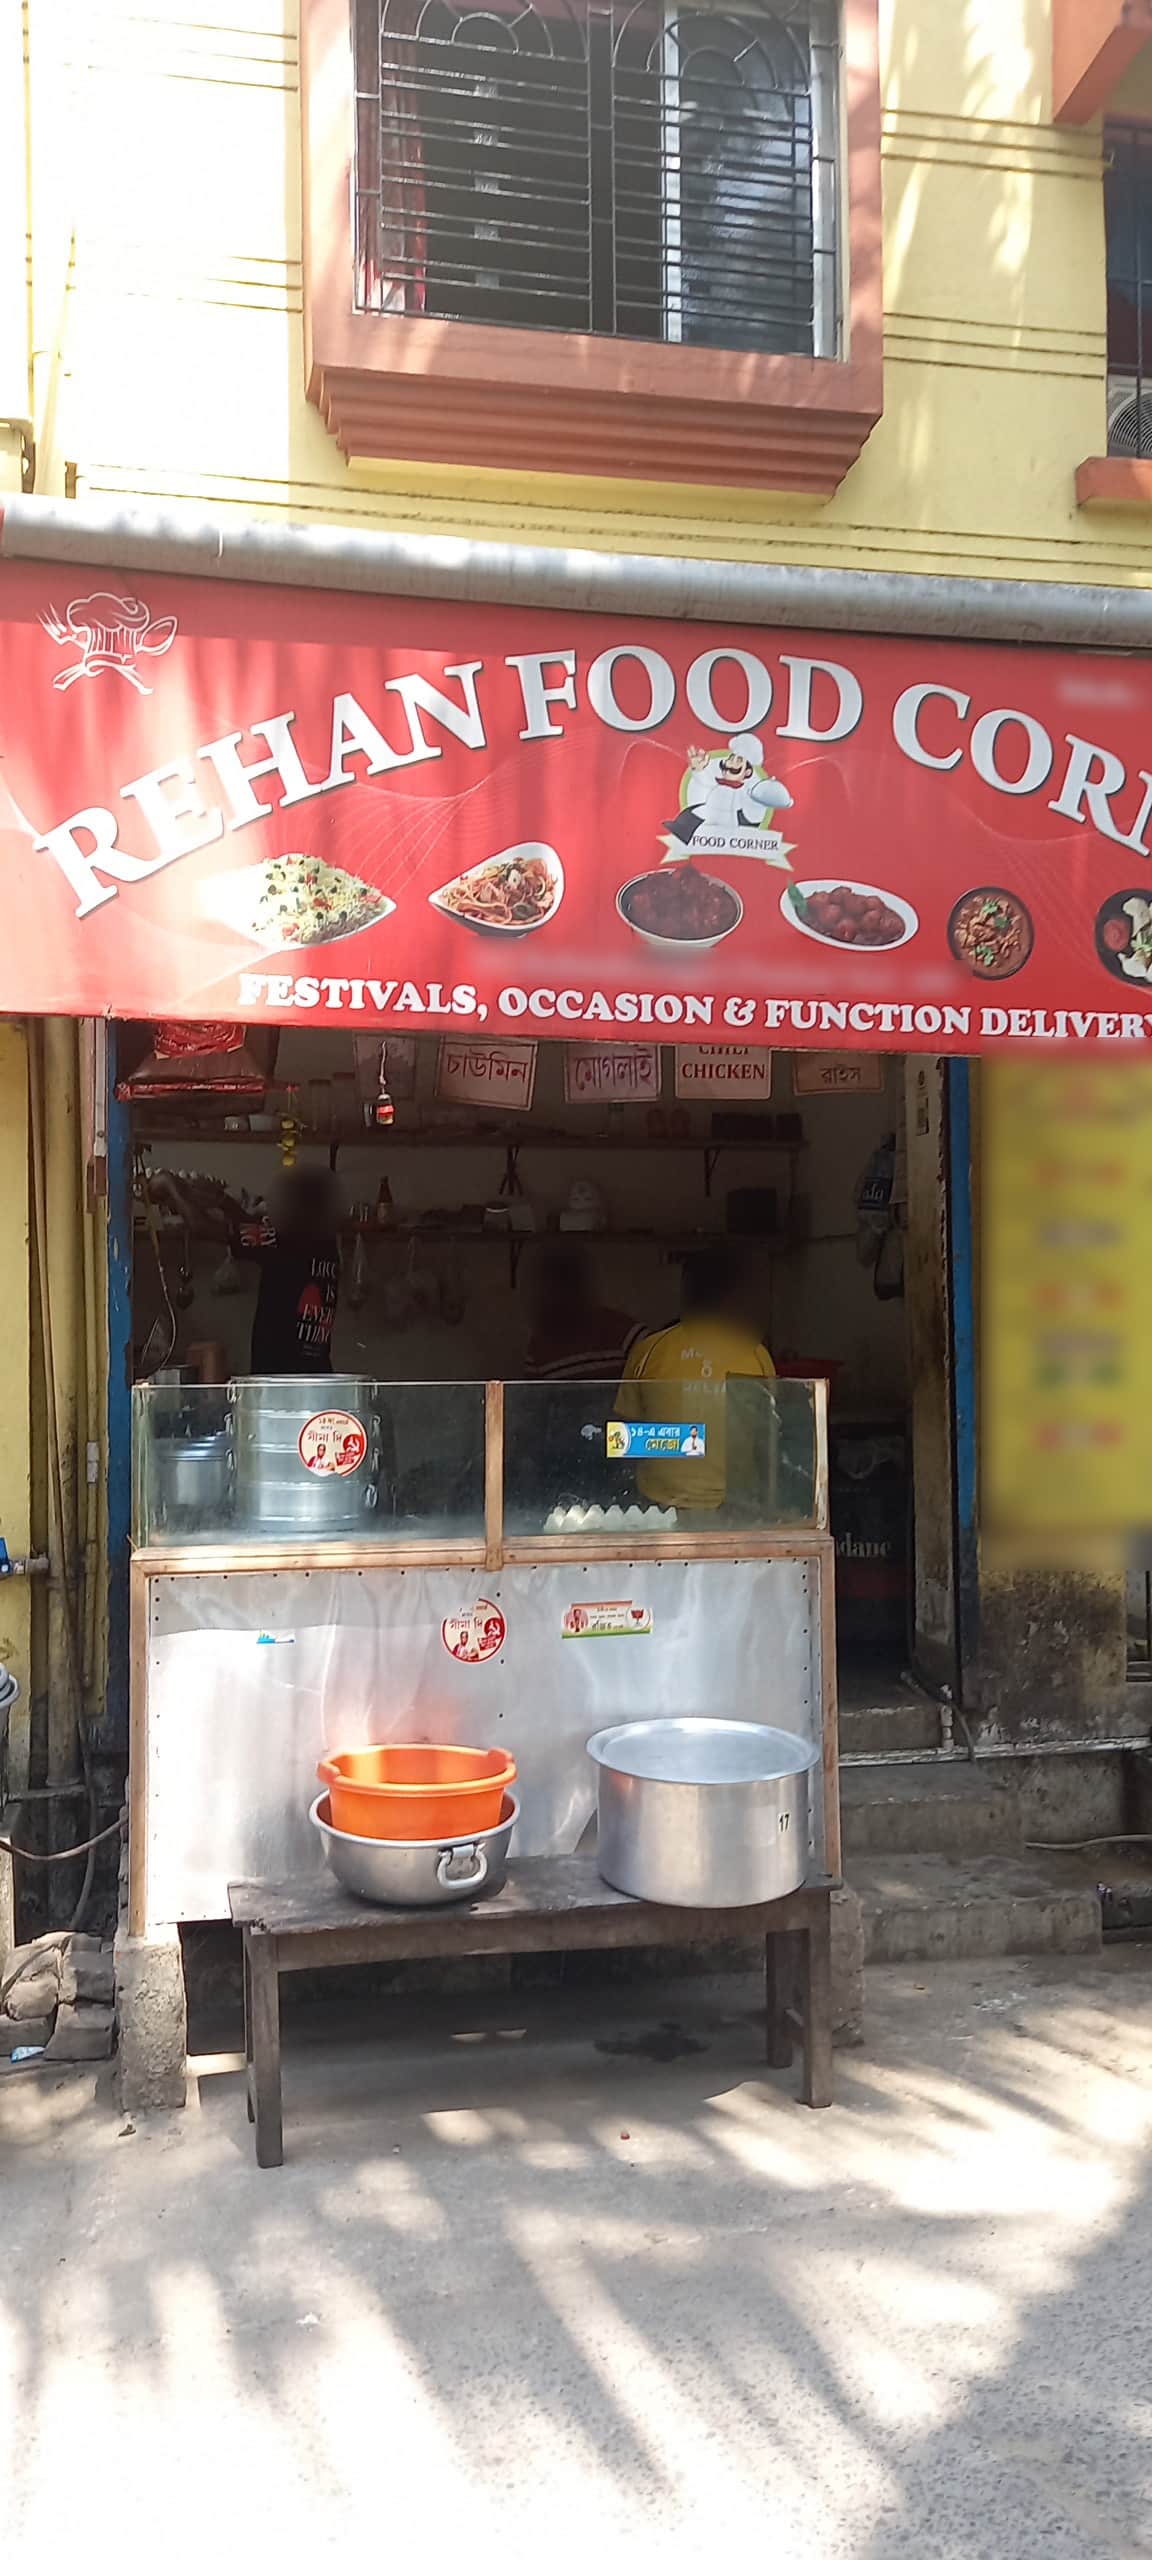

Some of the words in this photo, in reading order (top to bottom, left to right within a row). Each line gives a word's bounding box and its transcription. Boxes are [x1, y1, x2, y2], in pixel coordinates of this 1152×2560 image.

[34, 660, 488, 920] REHAN
[505, 645, 863, 743] FOOD
[892, 683, 1152, 858] COR
[691, 835, 726, 848] FOOD
[729, 837, 779, 851] CORNER
[238, 973, 488, 1022] FESTIVALS,
[499, 986, 715, 1027] OCCASION
[722, 996, 755, 1027] &
[765, 1000, 972, 1037] FUNCTION
[446, 1048, 528, 1083] চাউমিন
[681, 1063, 766, 1080] CHICKEN
[779, 1813, 790, 1833] 17
